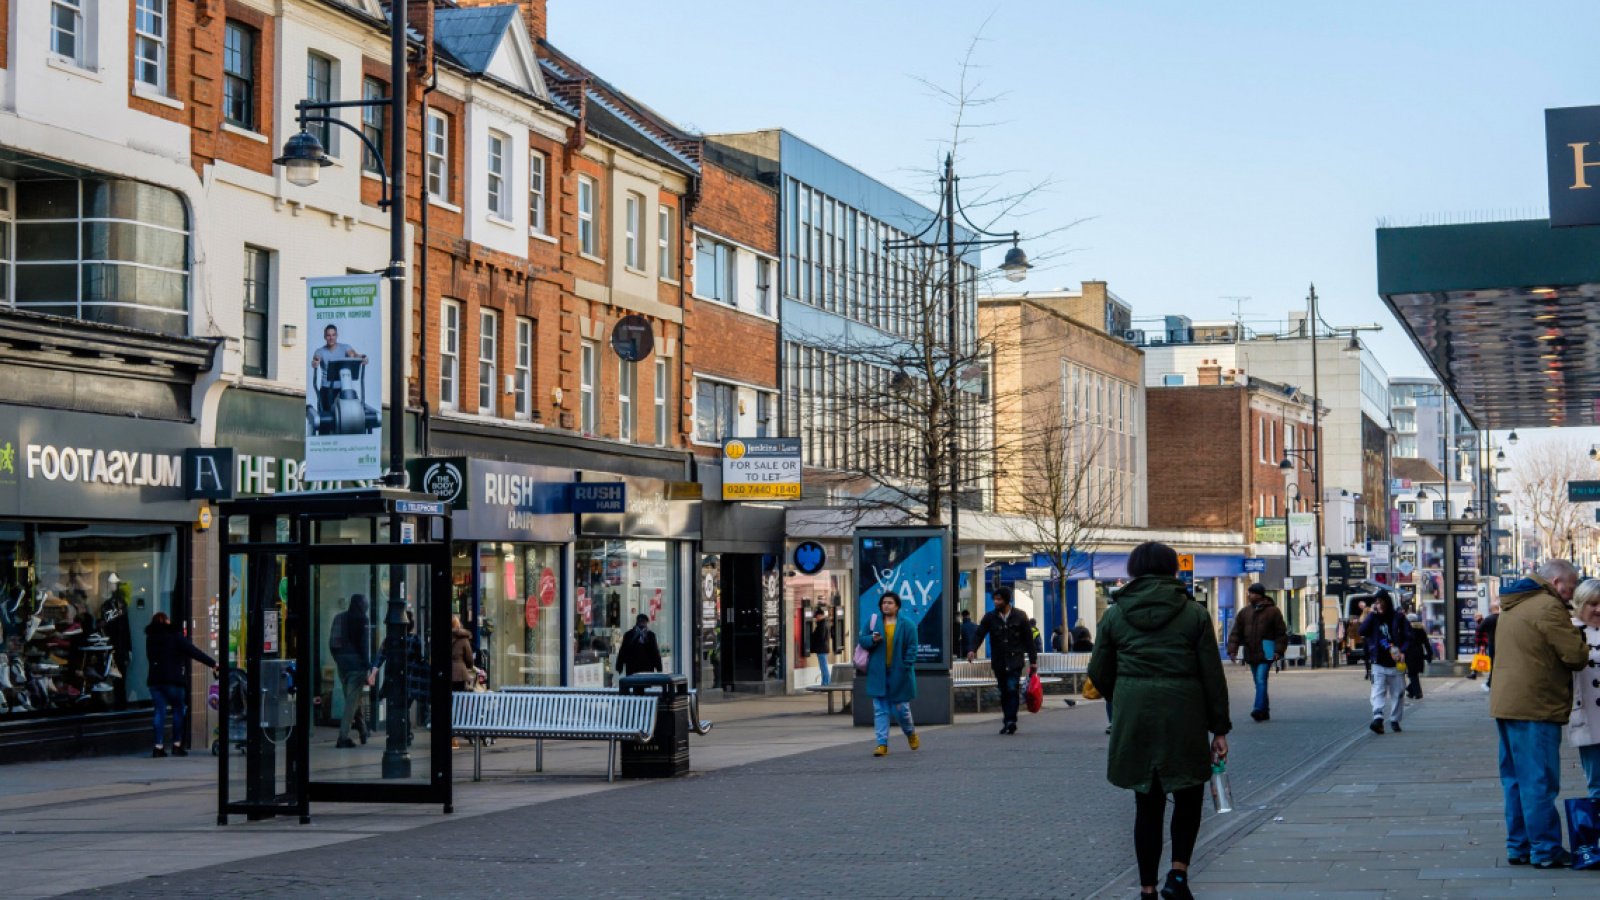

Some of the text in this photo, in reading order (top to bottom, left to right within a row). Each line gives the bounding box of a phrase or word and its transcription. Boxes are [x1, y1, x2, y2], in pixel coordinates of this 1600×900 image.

[27, 443, 182, 488] FOOTASYLUM
[730, 461, 797, 470] FOR SALE OR
[236, 454, 275, 494] THE
[745, 472, 781, 481] TO LET
[432, 489, 454, 497] SHOP
[485, 472, 533, 507] RUSH
[574, 485, 622, 500] RUSH
[407, 503, 438, 513] TELEPHONE
[596, 500, 621, 510] HAIR
[508, 511, 533, 530] HAIR
